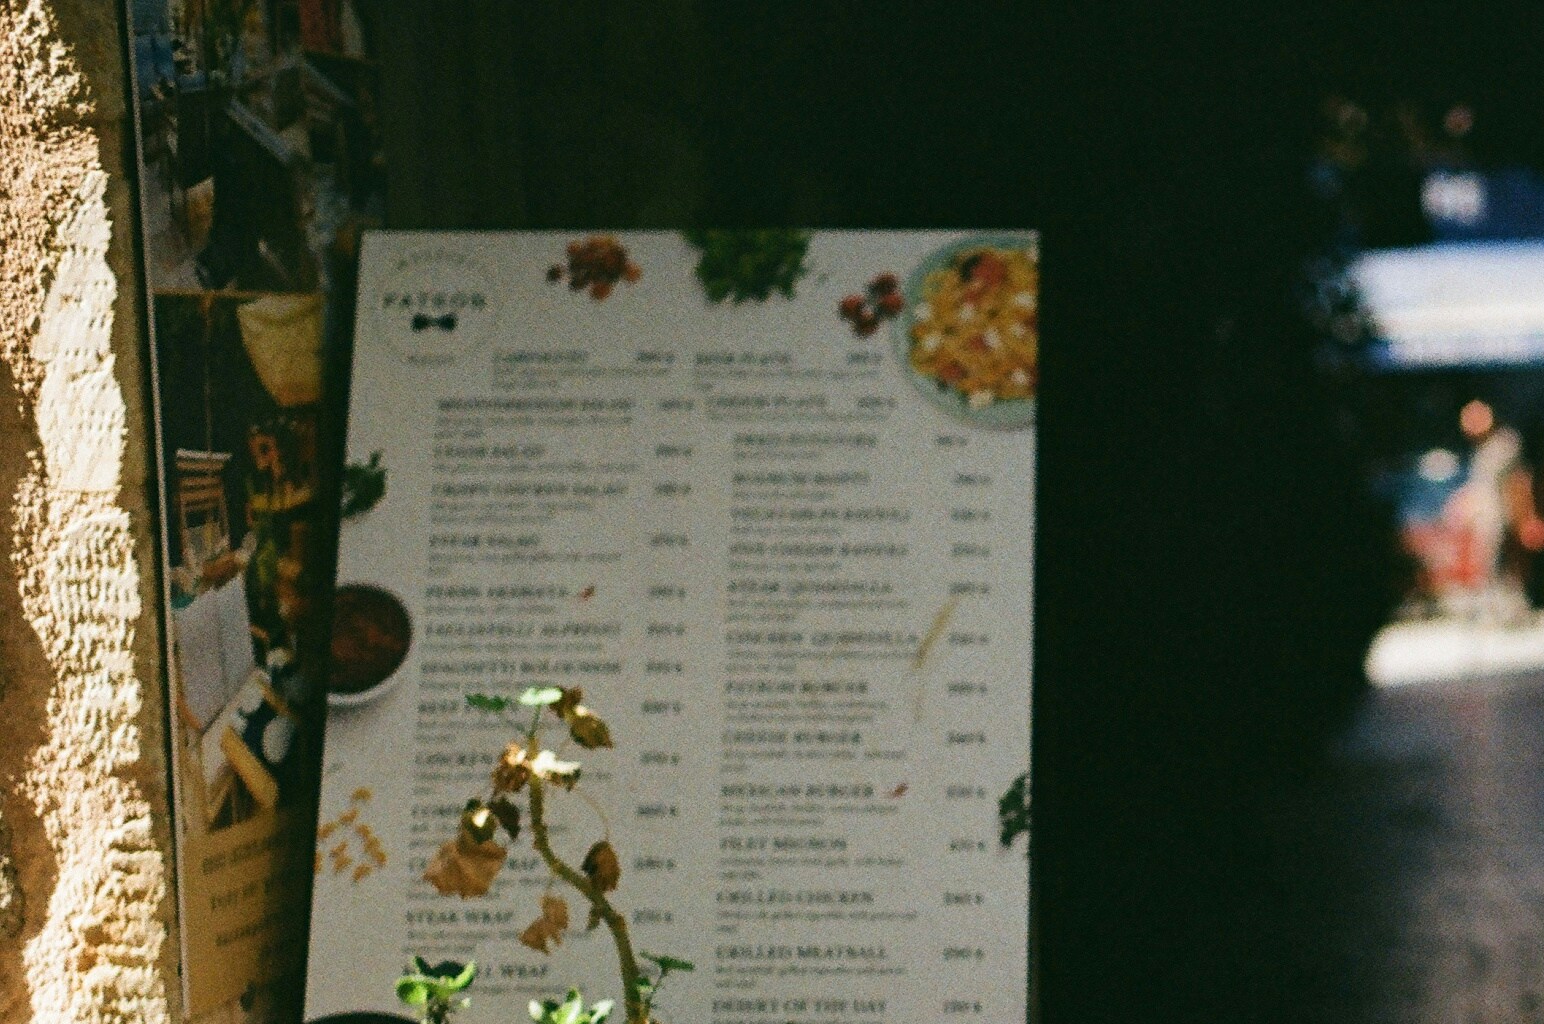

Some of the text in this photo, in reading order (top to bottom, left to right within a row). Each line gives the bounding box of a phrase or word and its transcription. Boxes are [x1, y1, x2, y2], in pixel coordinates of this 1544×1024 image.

[800, 681, 868, 694] BURGER
[793, 731, 862, 744] BURGER
[805, 784, 874, 798] BURGER
[716, 891, 873, 905] GRILLED CHICKEN
[464, 910, 514, 924] WRAP
[715, 946, 886, 960] GRILLED MEATBALL
